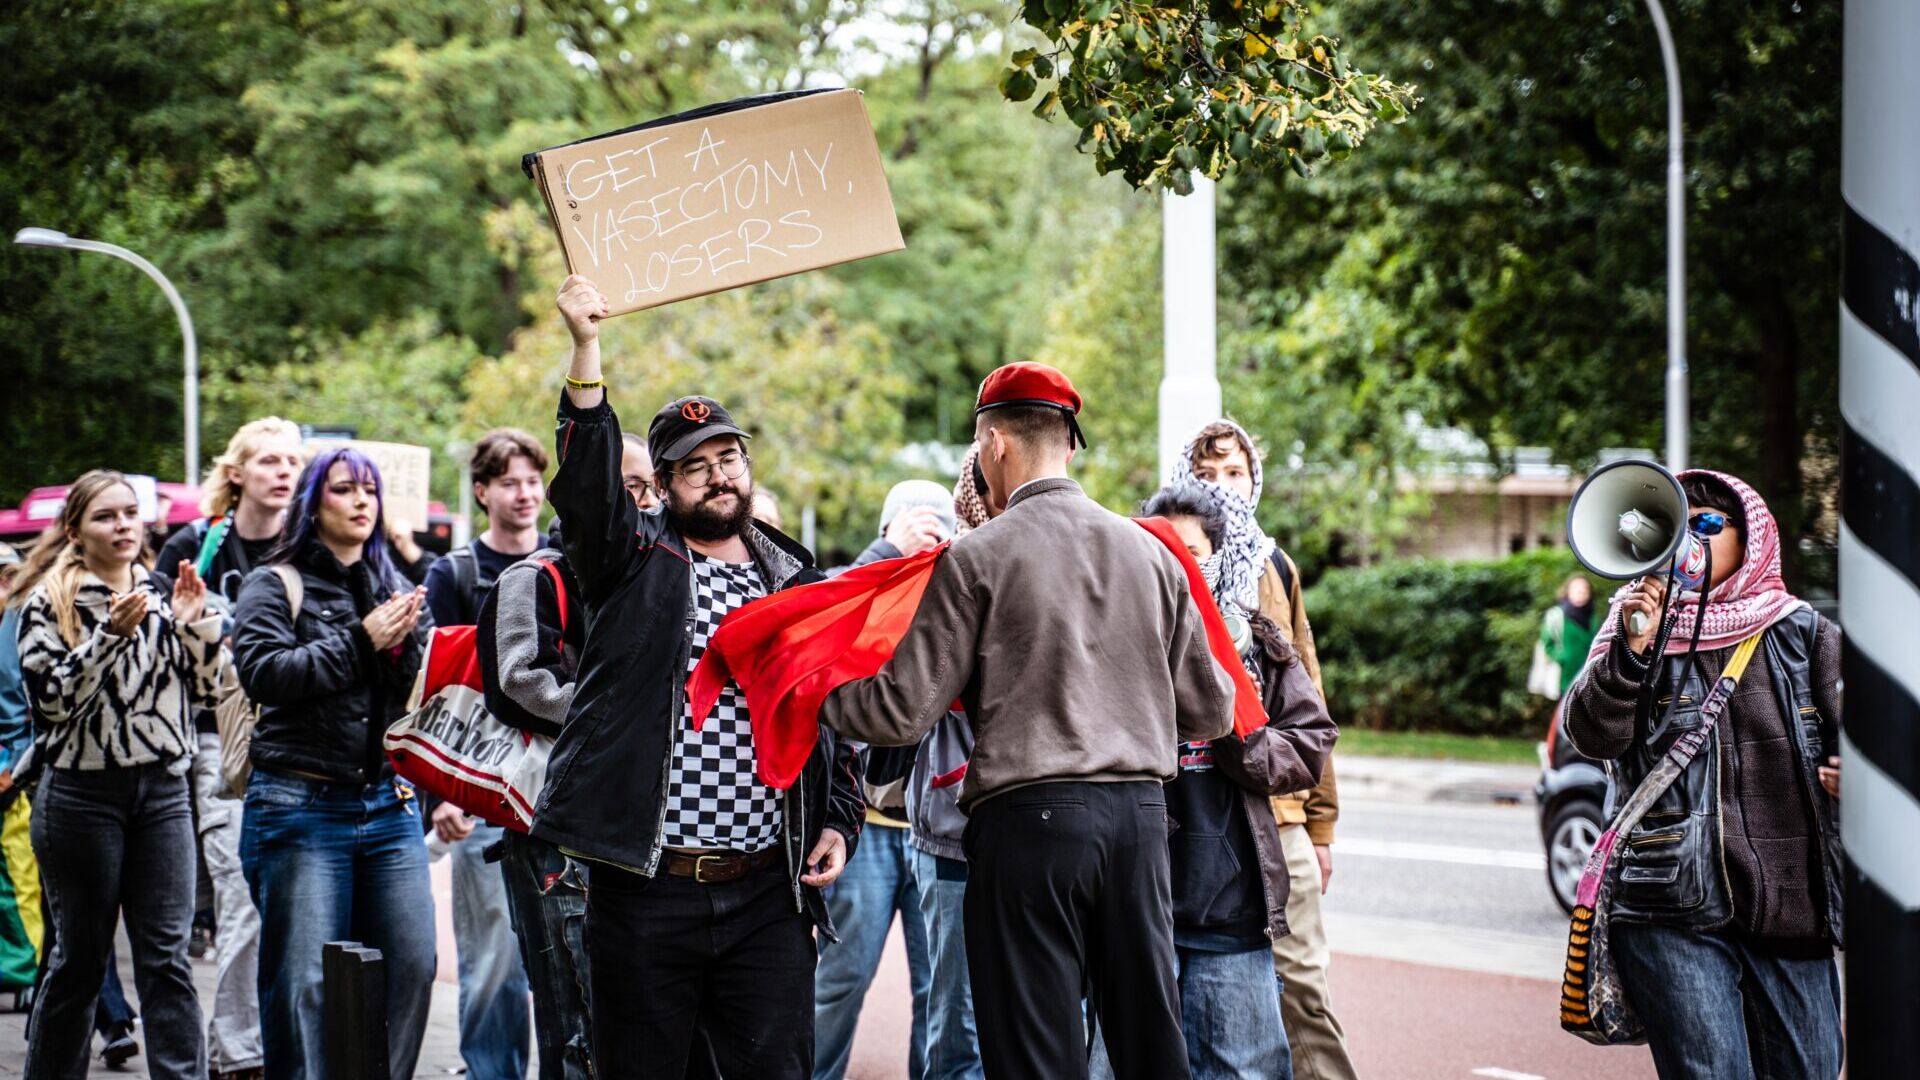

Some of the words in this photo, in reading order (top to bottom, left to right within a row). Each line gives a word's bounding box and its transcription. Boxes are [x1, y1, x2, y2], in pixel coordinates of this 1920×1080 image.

[567, 137, 669, 201] GET
[684, 127, 725, 171] A
[573, 142, 853, 267] VASECTOMY,
[624, 209, 822, 302] LOSERS
[378, 449, 422, 477] OVE
[409, 695, 514, 767] Marlboro
